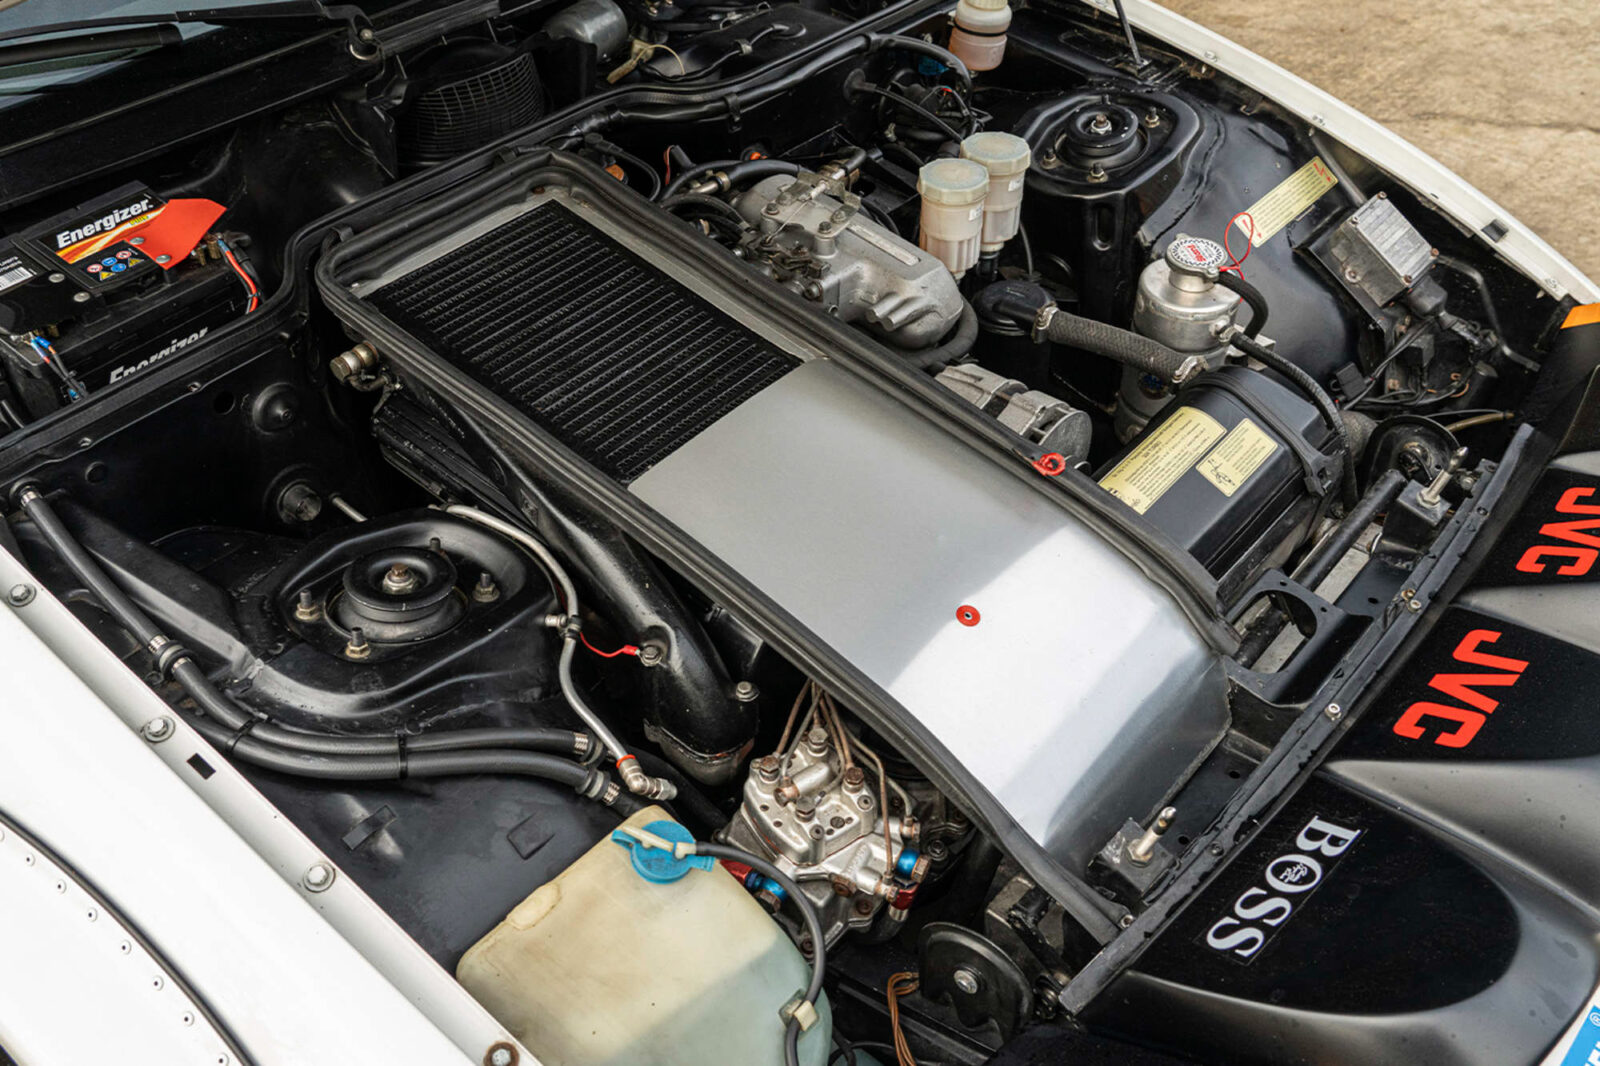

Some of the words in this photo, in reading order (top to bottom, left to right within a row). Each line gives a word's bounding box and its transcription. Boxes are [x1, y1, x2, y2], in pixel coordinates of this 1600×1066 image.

[1515, 487, 1600, 576] JVC
[1392, 629, 1530, 748] JVC
[1206, 815, 1361, 957] BOSS
